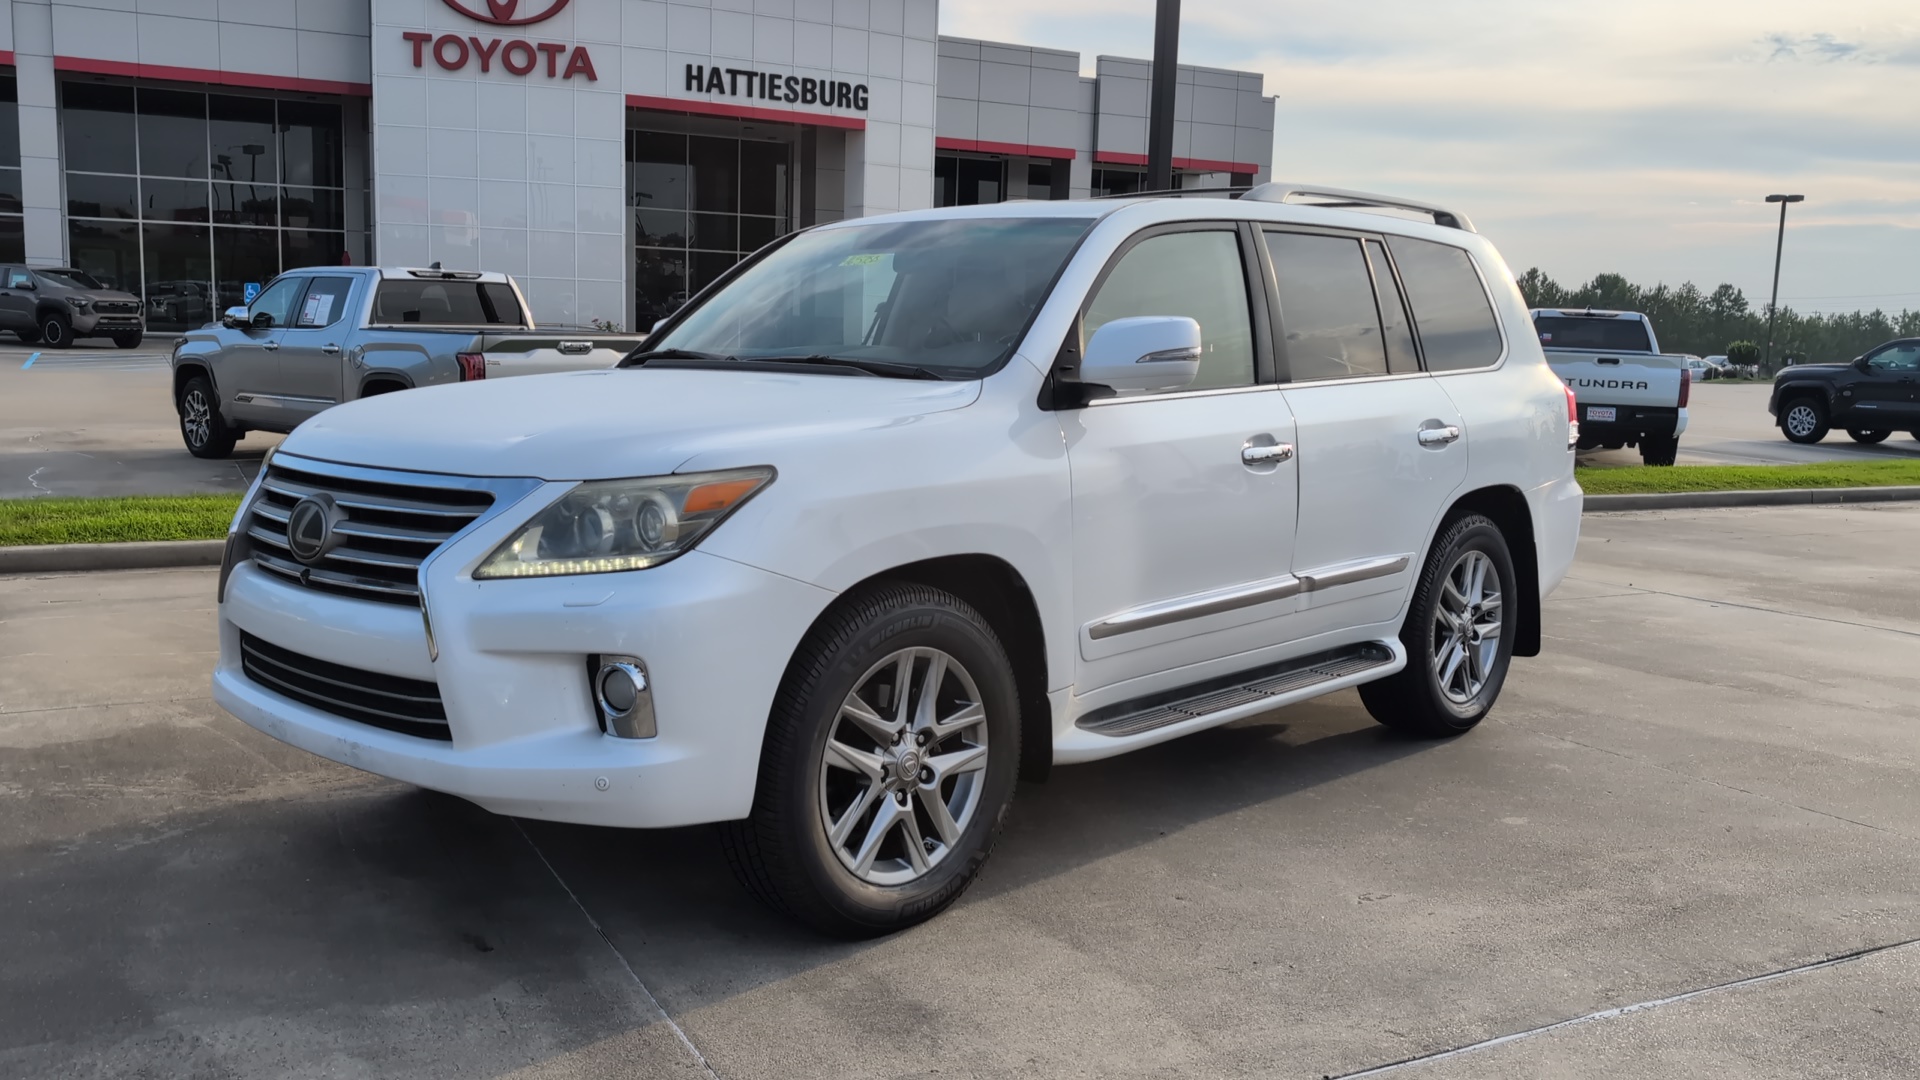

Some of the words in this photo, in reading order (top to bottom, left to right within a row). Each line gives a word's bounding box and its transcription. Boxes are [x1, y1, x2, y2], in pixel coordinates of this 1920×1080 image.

[402, 31, 598, 81] TOYOTA
[685, 63, 869, 111] HATTIESBURG
[1565, 378, 1648, 390] TUNDRA
